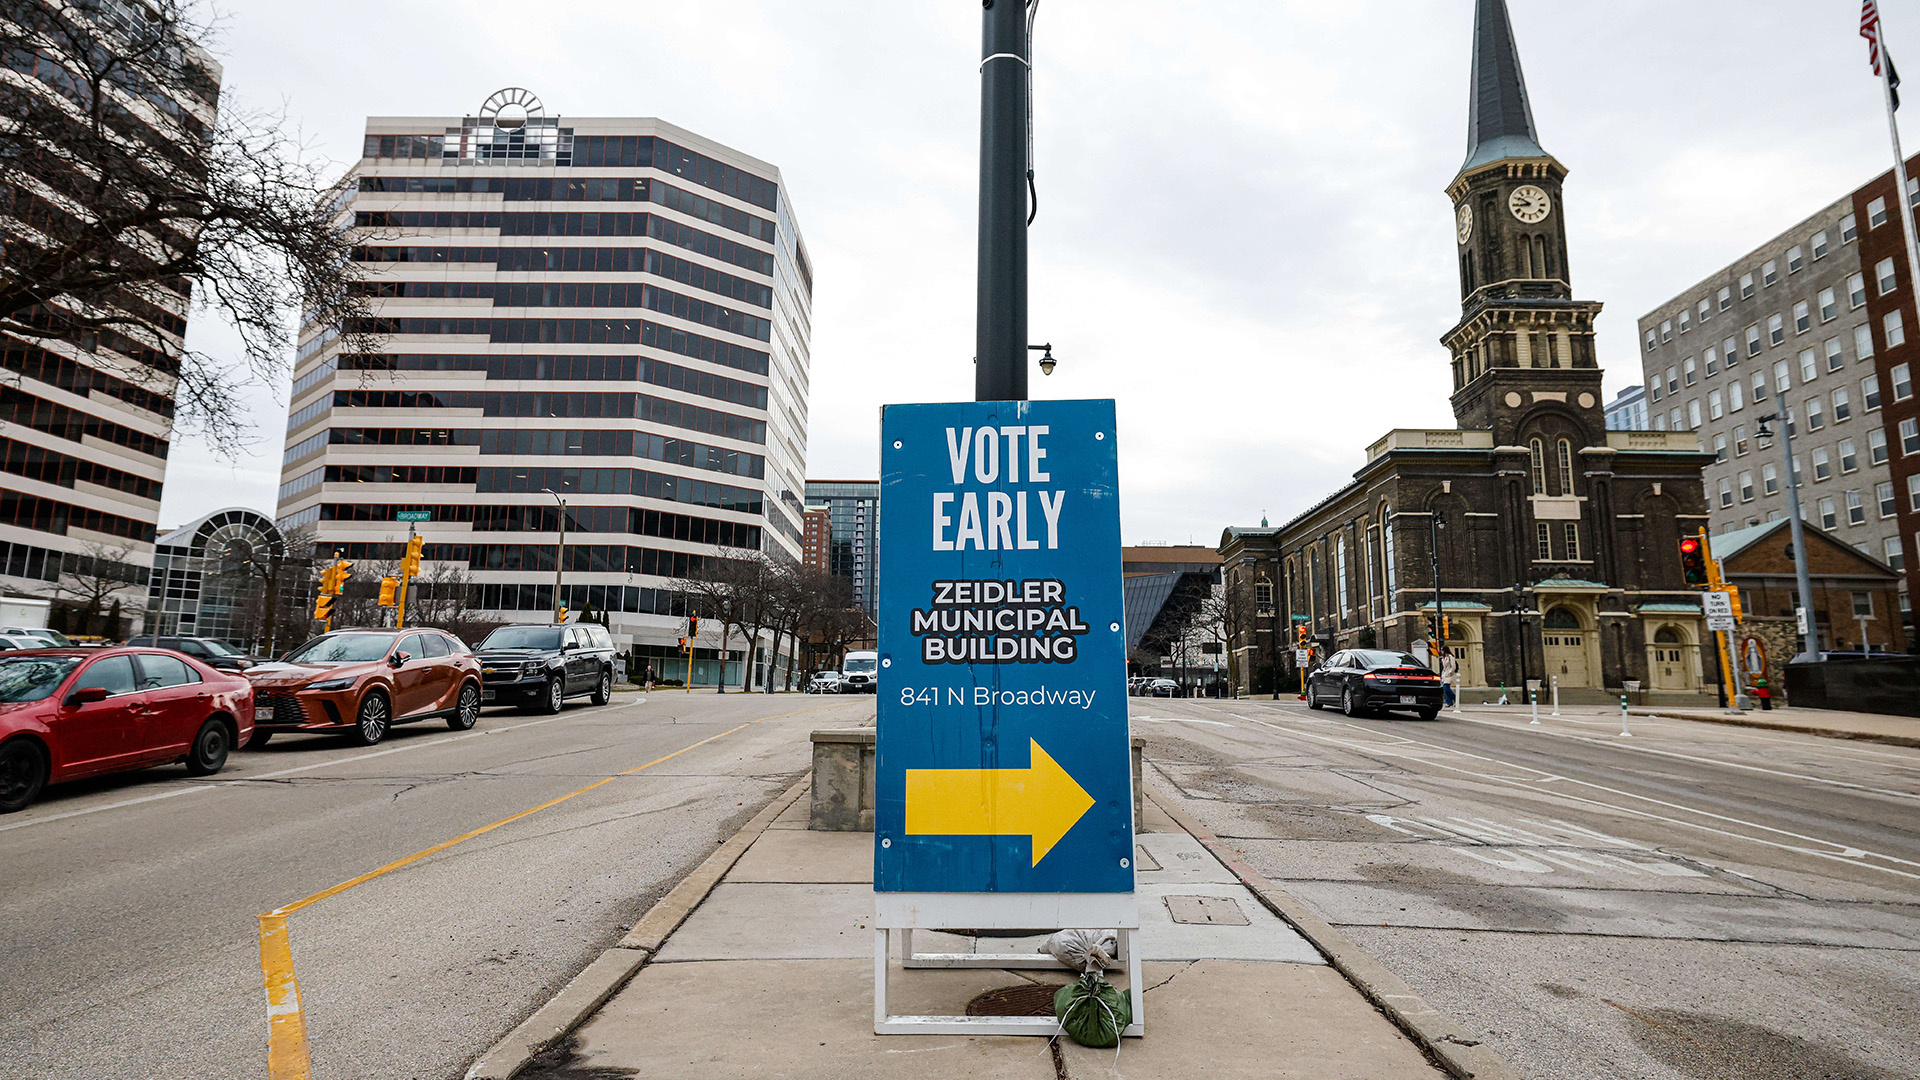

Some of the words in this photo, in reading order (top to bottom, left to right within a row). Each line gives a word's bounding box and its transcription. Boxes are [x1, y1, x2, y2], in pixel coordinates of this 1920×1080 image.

[945, 425, 1050, 484] VOTE
[932, 490, 1066, 551] EARLY
[934, 581, 1063, 604] ZEIDLER
[913, 608, 1087, 632] MUNICIPAL
[924, 636, 1074, 660] BUILDING
[900, 687, 938, 706] 841
[948, 687, 964, 706] N
[974, 685, 1096, 710] Broadway
